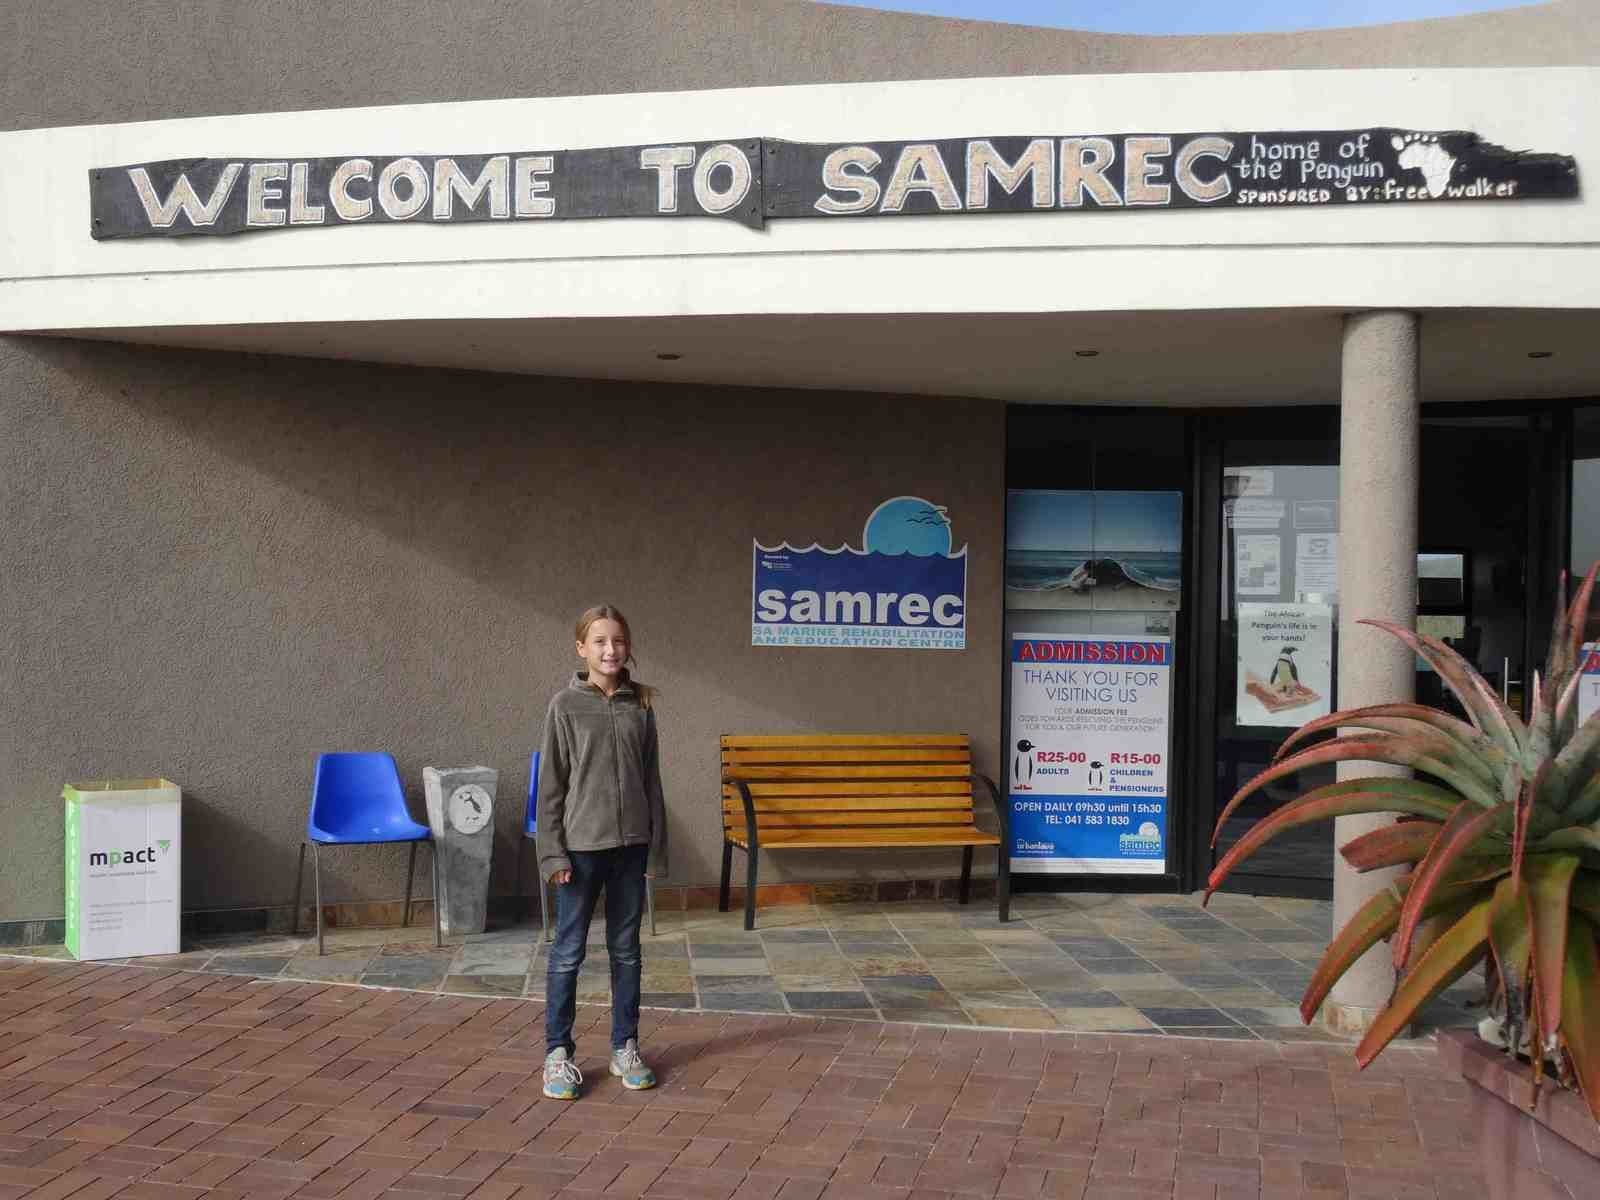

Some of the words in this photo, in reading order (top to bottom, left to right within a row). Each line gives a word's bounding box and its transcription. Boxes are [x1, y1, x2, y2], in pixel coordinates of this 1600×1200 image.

[1251, 135, 1320, 160] home
[1339, 134, 1371, 158] of
[1232, 160, 1282, 180] the
[1300, 158, 1384, 188] Penguin
[127, 155, 555, 229] WELCOME
[640, 144, 752, 215] TO
[814, 135, 1235, 215] SAMREC
[1448, 178, 1516, 198] walker
[757, 589, 965, 626] samrec
[753, 626, 774, 635] SA
[777, 626, 839, 637] MARINE
[841, 627, 965, 640] REHABILITATION
[753, 636, 789, 645] AND
[792, 636, 893, 646] EDUCATION
[897, 638, 965, 648] CENTRE
[1021, 641, 1166, 664] ADMISSION
[1024, 669, 1079, 685] THANK
[1084, 670, 1120, 686] YOU
[1125, 671, 1161, 686] FOR
[1046, 687, 1113, 702] VISITING
[1119, 688, 1138, 703] US
[1036, 751, 1087, 763] R25-00
[1110, 752, 1161, 765] R15-00
[1036, 767, 1070, 775] ADULTS
[1110, 769, 1154, 777] CHILDREN
[1109, 785, 1165, 793] PENSIONERS
[1014, 801, 1042, 812] OPEN
[1045, 802, 1073, 812] DAILY
[1075, 802, 1106, 813] 09h30
[1108, 803, 1129, 813] until
[1132, 803, 1162, 814] 15h30
[1045, 815, 1062, 825] TEL:
[1065, 815, 1082, 825] 041
[1085, 815, 1103, 825] 583
[90, 847, 157, 868] mpact
